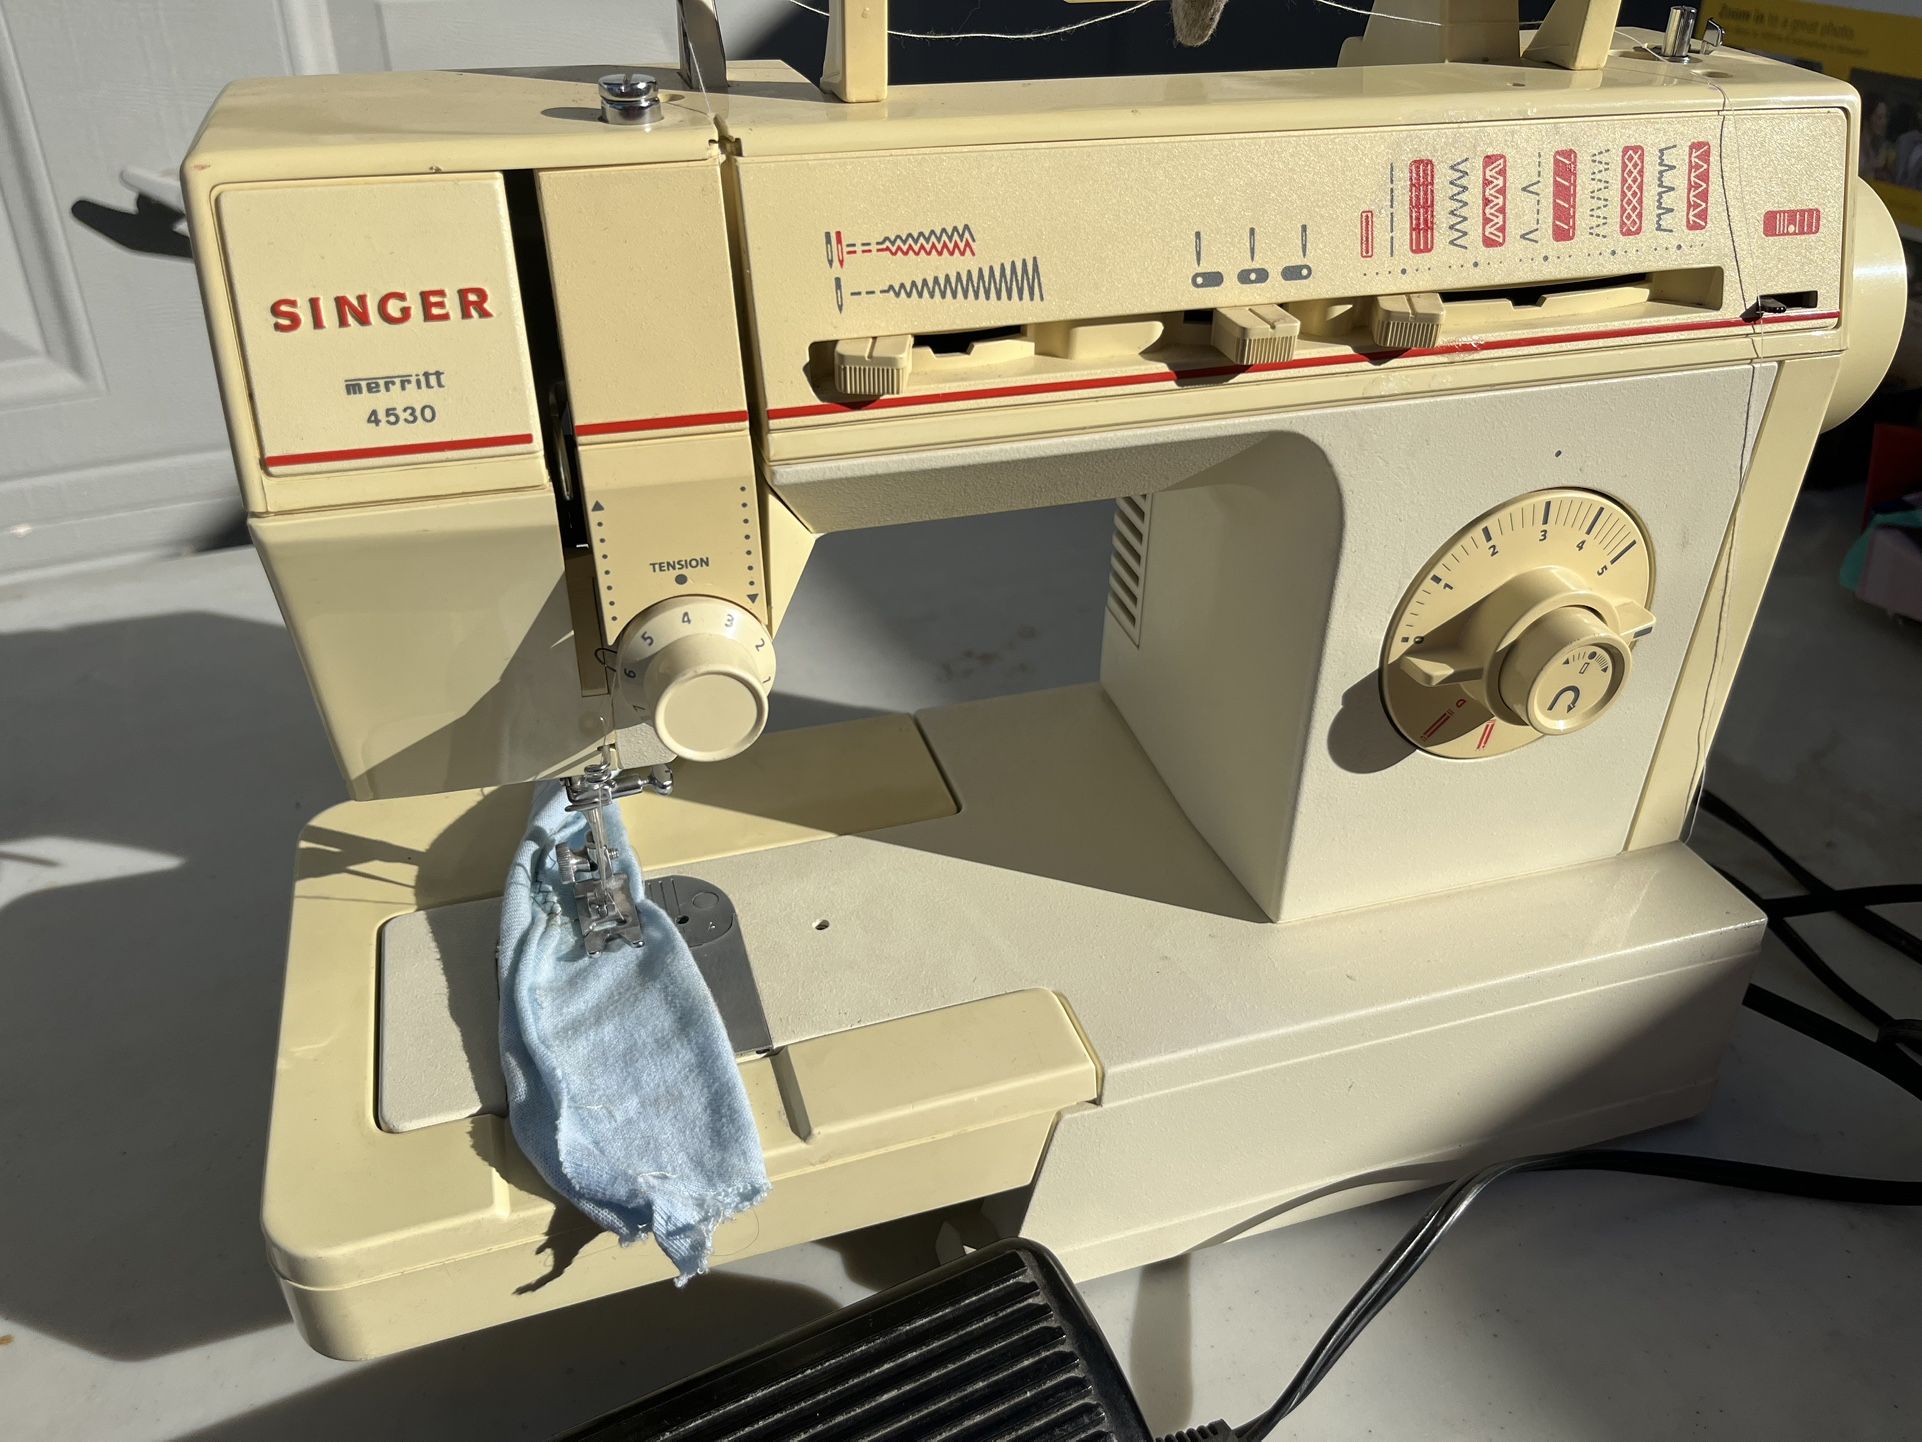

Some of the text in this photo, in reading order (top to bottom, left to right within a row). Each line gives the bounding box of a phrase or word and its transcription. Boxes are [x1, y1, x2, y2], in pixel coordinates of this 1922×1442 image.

[271, 287, 493, 333] SINGER
[345, 370, 445, 395] merritt
[367, 405, 436, 427] 4530
[650, 557, 710, 573] TENSION
[1488, 545, 1498, 556] 2
[1539, 530, 1548, 541] 3
[1576, 540, 1586, 551] 4
[1597, 565, 1608, 576] 5
[624, 668, 636, 679] 6
[641, 631, 655, 646] 5
[681, 612, 691, 625] 4
[725, 614, 735, 627] 3
[755, 639, 765, 652] 2
